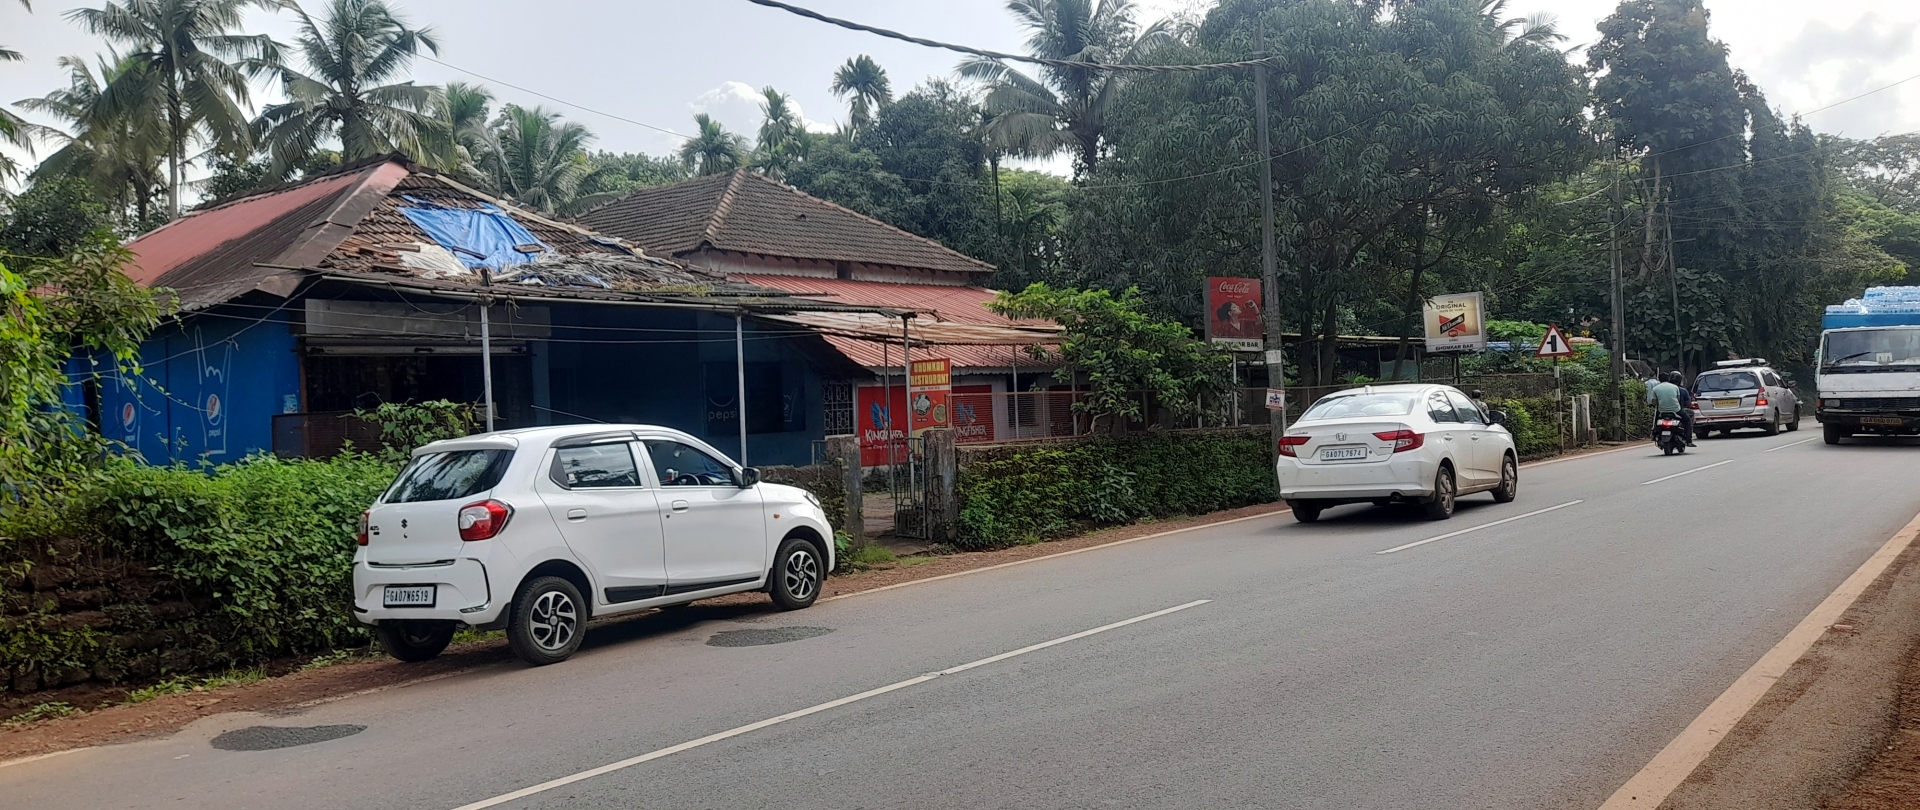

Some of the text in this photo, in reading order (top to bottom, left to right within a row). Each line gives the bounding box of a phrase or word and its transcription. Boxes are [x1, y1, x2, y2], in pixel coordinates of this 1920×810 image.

[910, 373, 949, 386] RESTAURANT
[708, 407, 737, 422] pepsi
[208, 428, 221, 438] pepsi
[1326, 449, 1361, 458] GA07L7674
